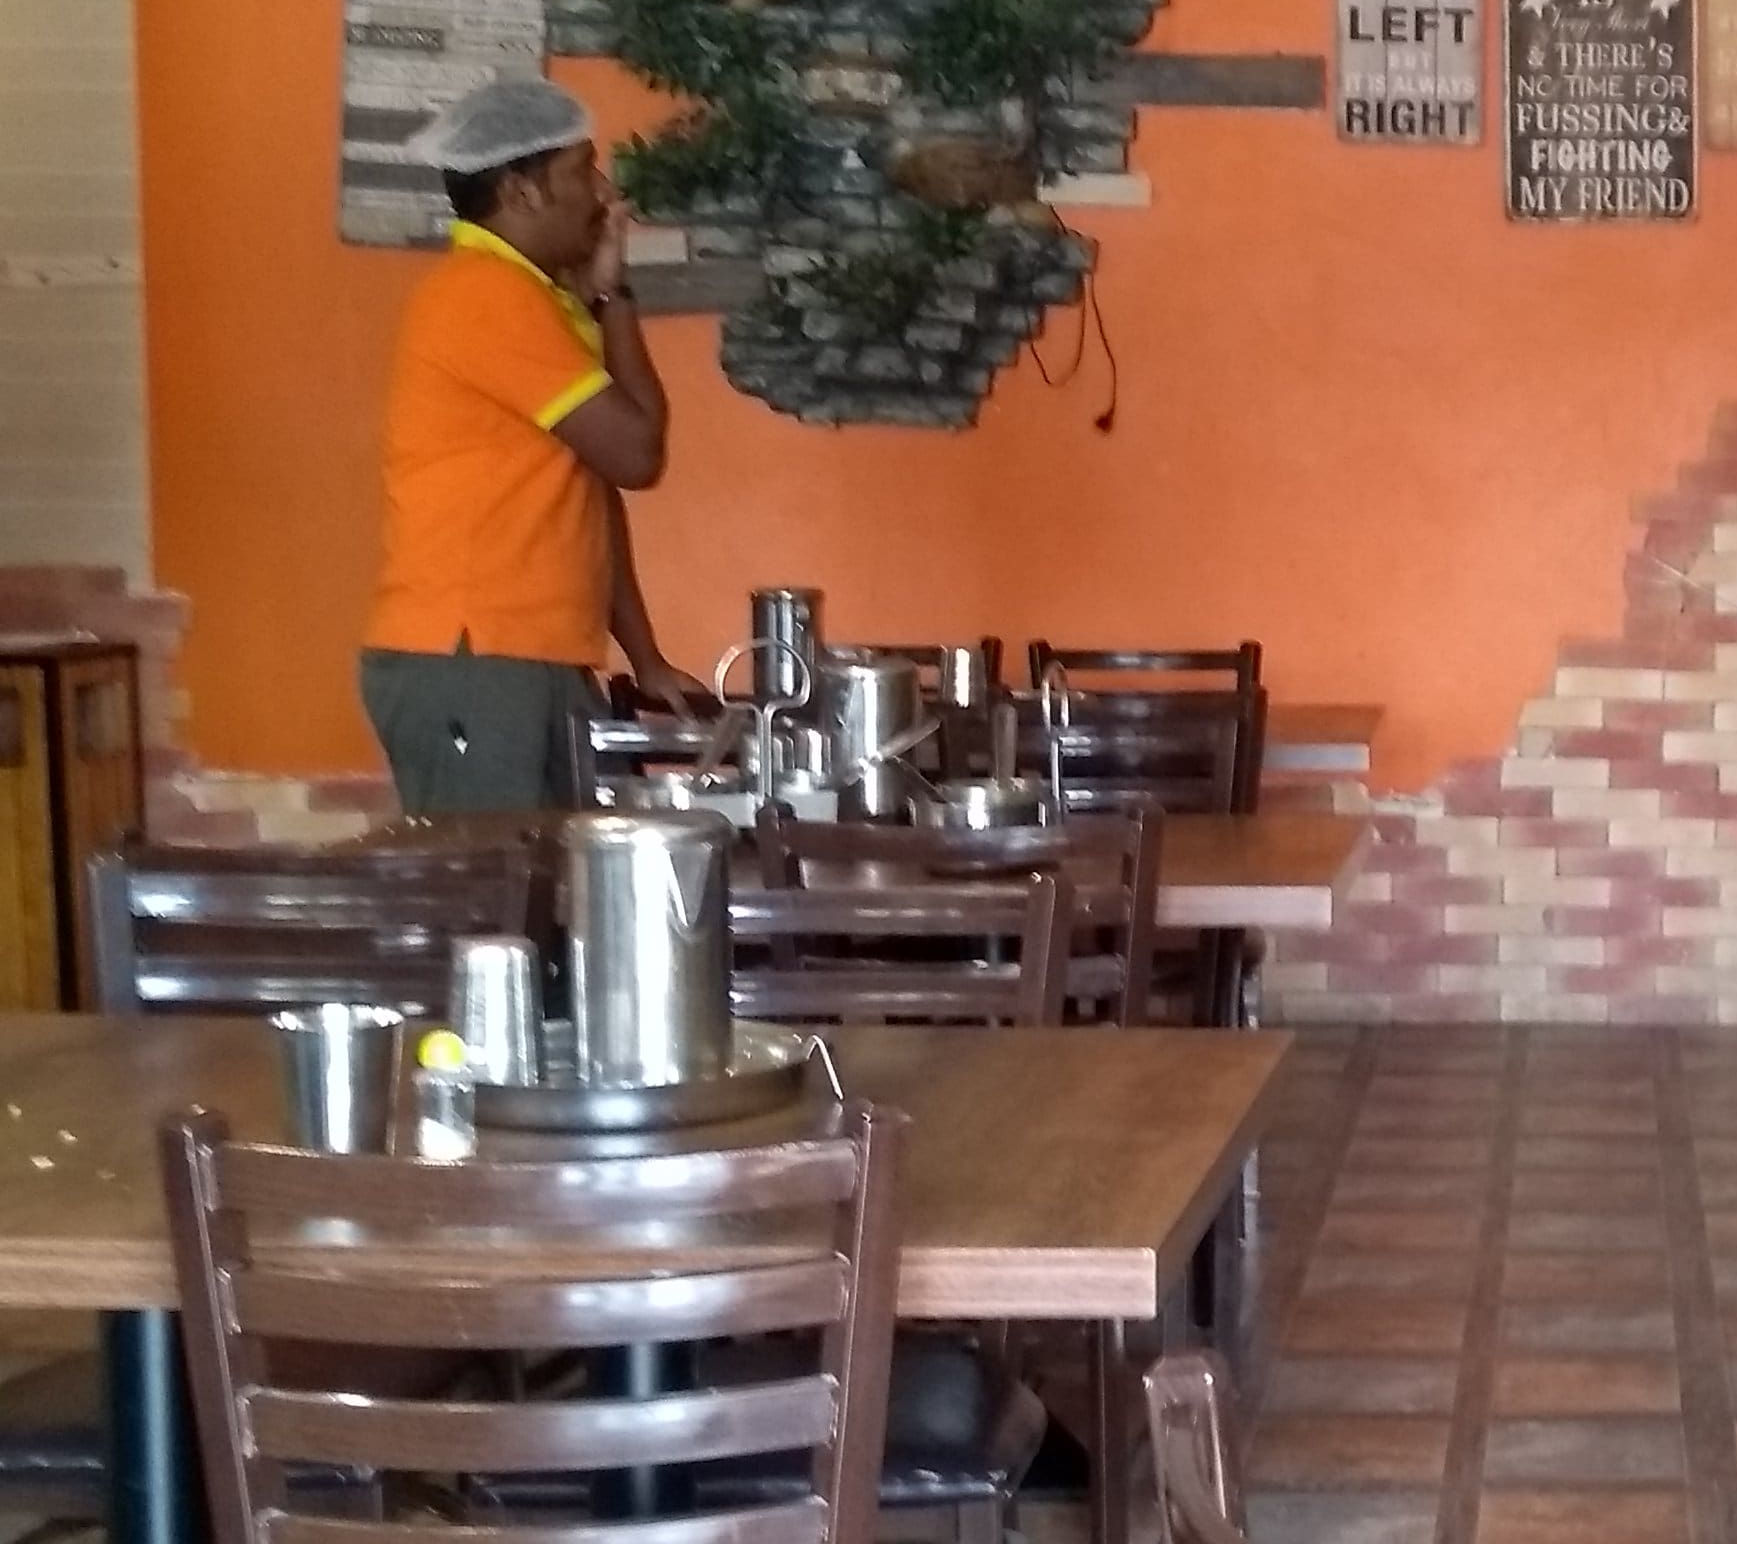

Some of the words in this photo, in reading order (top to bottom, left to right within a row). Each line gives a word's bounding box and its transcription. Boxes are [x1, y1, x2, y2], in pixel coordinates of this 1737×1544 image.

[1349, 5, 1474, 44] LEFT
[1554, 36, 1674, 71] THERE'S
[1563, 74, 1625, 98] TIME
[1634, 74, 1689, 100] FOR
[1345, 97, 1475, 136] RIGHT
[1531, 138, 1674, 171] FIGHTING
[1518, 176, 1568, 212] MY
[1578, 176, 1690, 213] FRIEND
